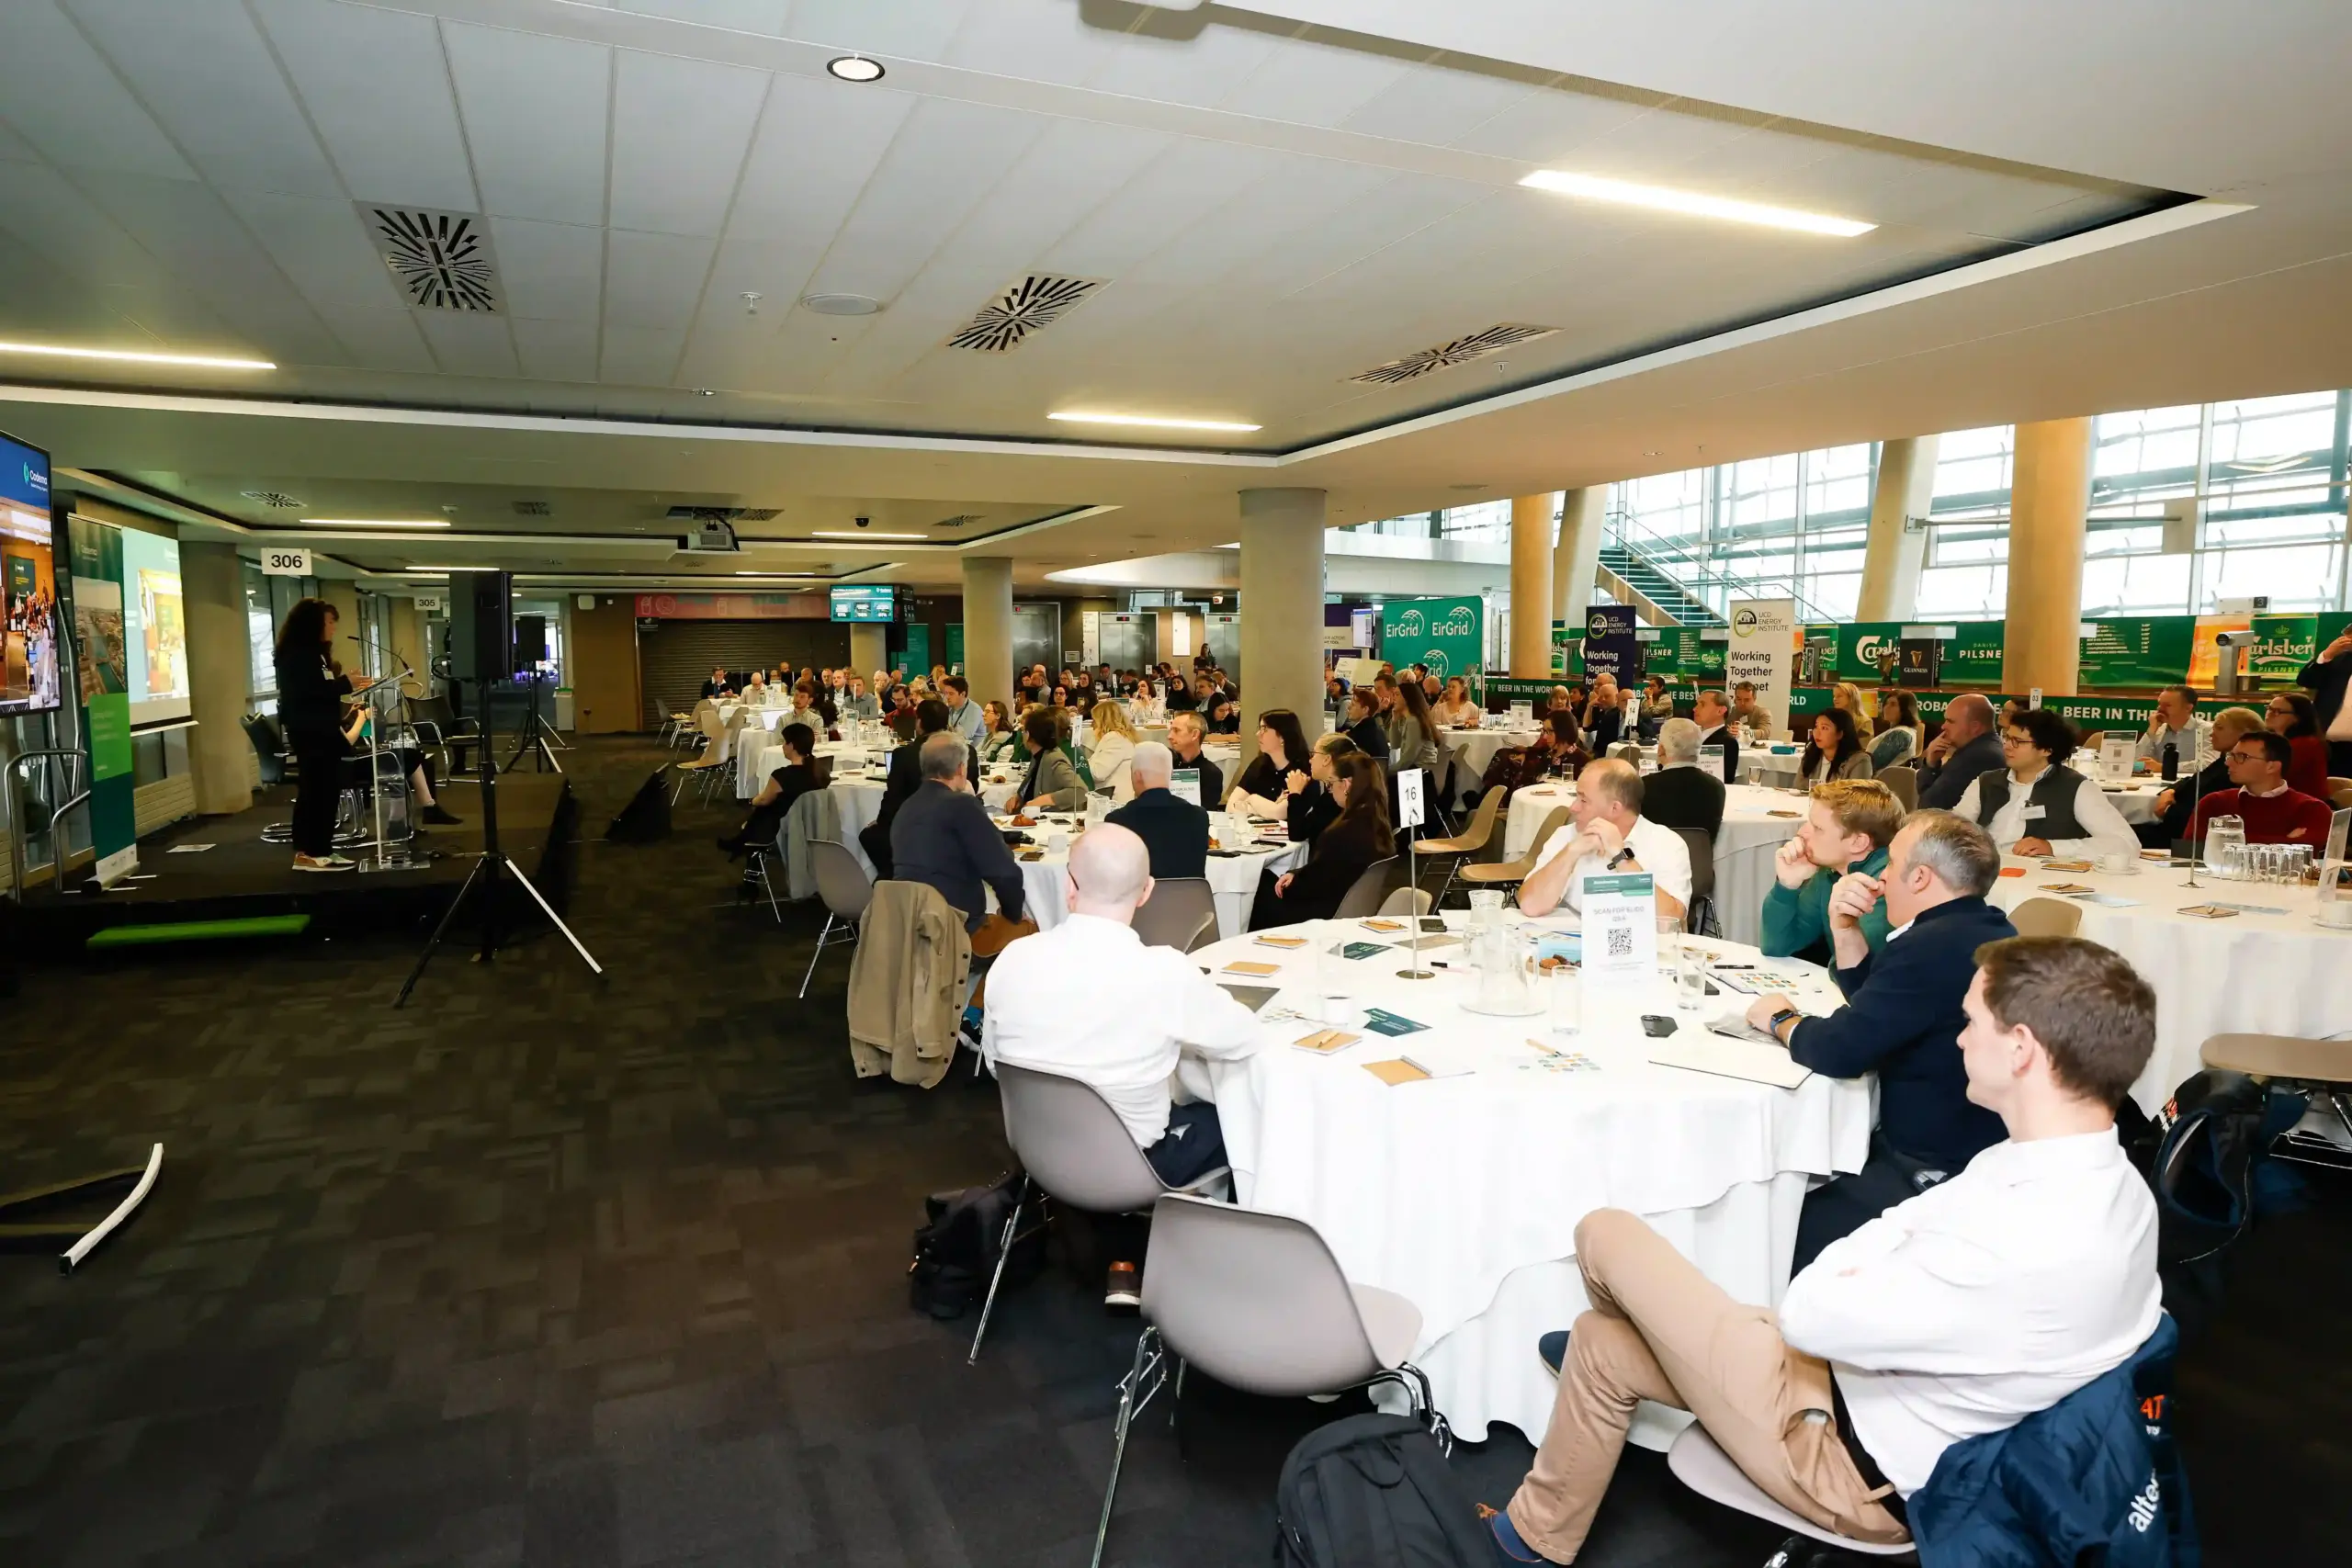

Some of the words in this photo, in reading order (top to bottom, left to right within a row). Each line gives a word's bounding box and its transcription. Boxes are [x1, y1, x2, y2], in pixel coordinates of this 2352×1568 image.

[29, 469, 48, 485] Codema
[271, 555, 302, 569] 306
[419, 599, 435, 607] 305
[1385, 623, 1419, 637] EirGrid
[1431, 621, 1468, 637] EirGrid
[1587, 650, 1619, 661] Working
[1731, 651, 1770, 663] Working
[1959, 649, 2002, 659] PILSNE
[1586, 663, 1620, 674] Together
[1730, 666, 1772, 678] Together
[1513, 684, 1521, 693] IN
[1521, 685, 1533, 694] THE
[1535, 685, 1552, 694] WOR
[2063, 705, 2101, 719] BEER
[2105, 707, 2122, 720] IN
[1405, 786, 1417, 801] 16
